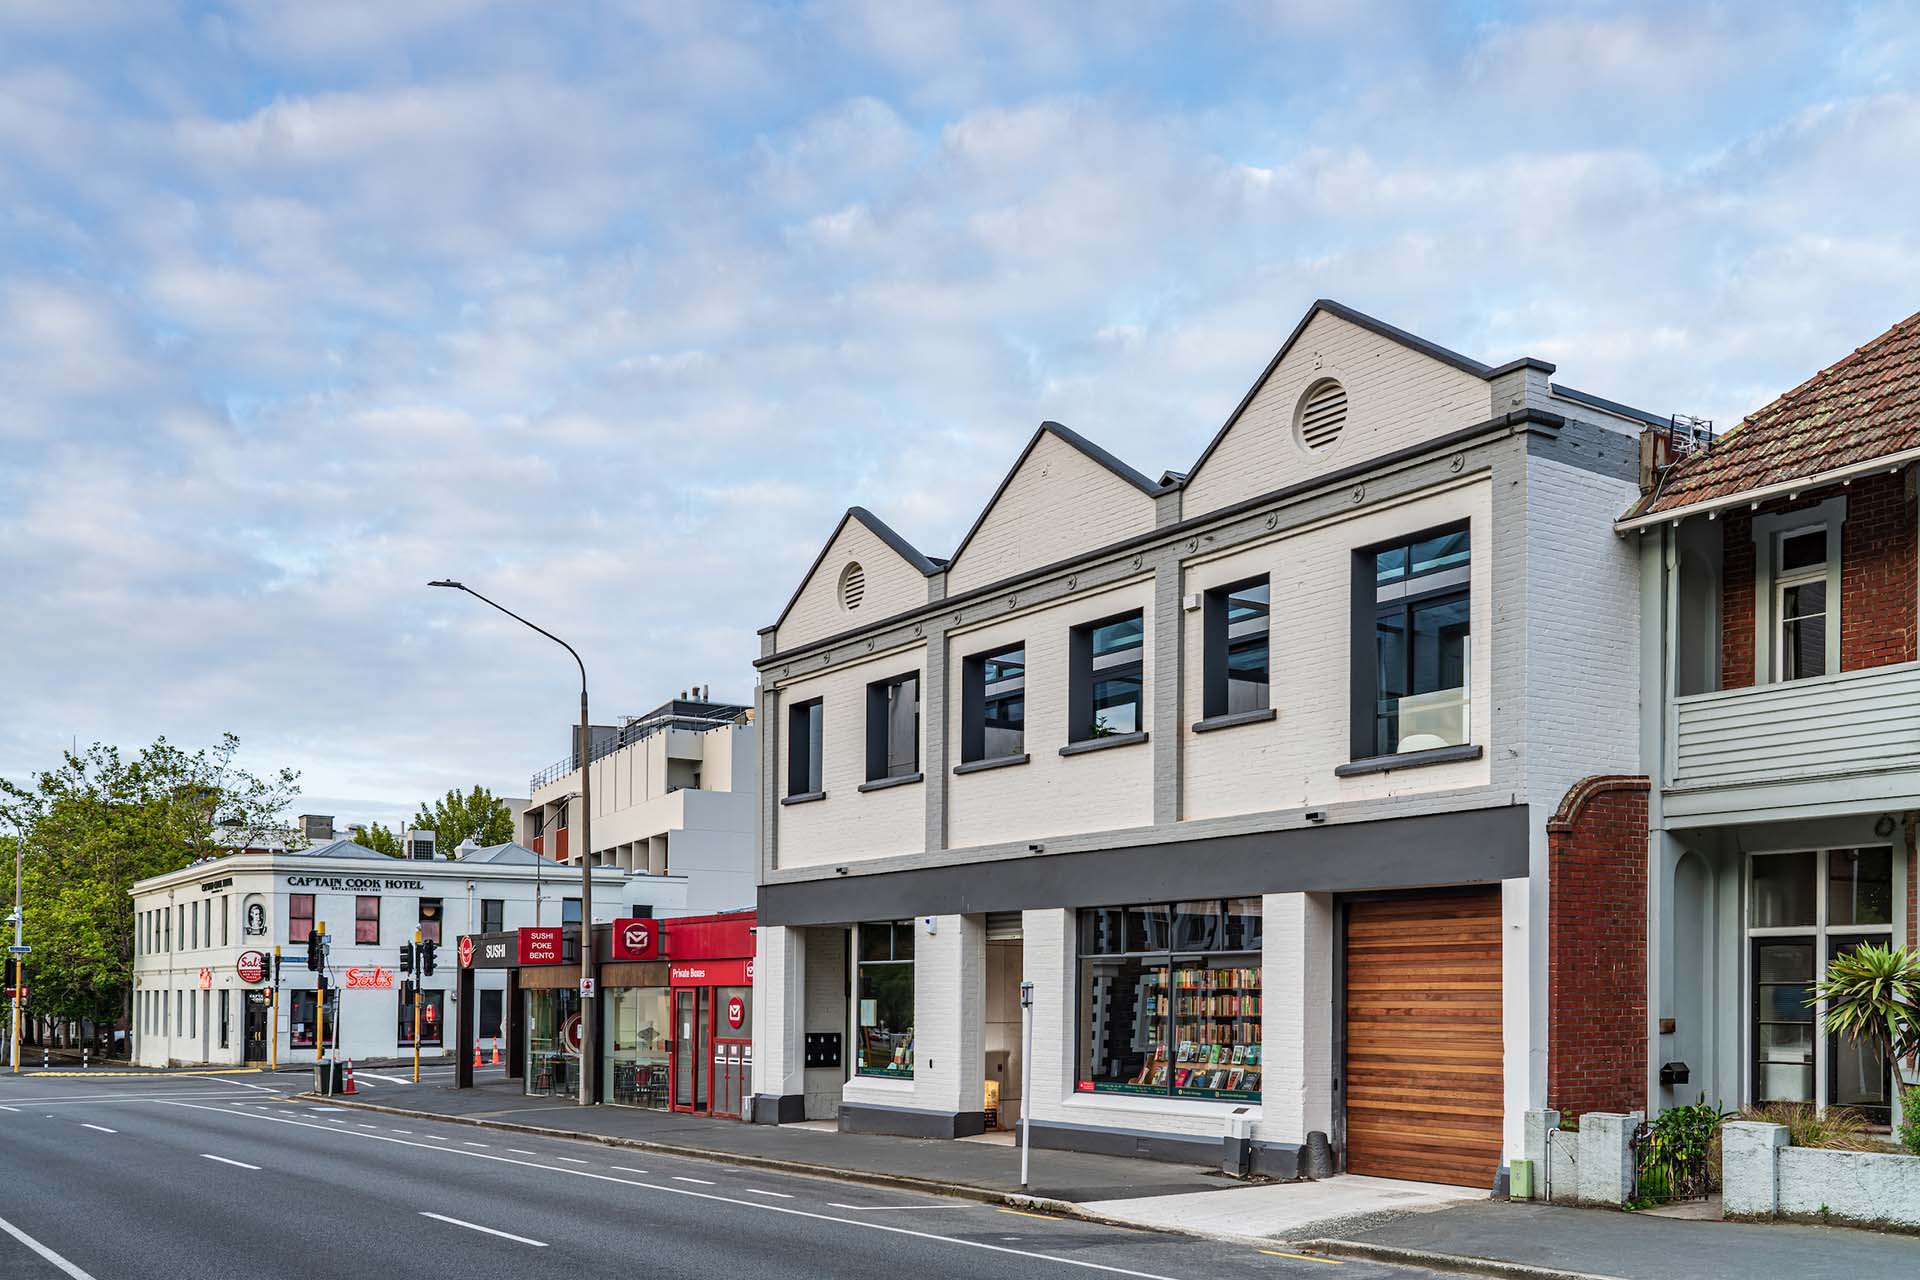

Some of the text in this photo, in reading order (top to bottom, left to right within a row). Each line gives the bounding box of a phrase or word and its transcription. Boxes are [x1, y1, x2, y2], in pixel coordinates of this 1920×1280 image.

[287, 876, 424, 890] CAPTAIN COOK HOTEL
[530, 932, 554, 940] SUSHI
[486, 943, 506, 959] SUSHI
[531, 942, 552, 950] POKE
[529, 951, 555, 960] BENTO
[347, 966, 393, 988] Sal's
[672, 968, 690, 978] Private
